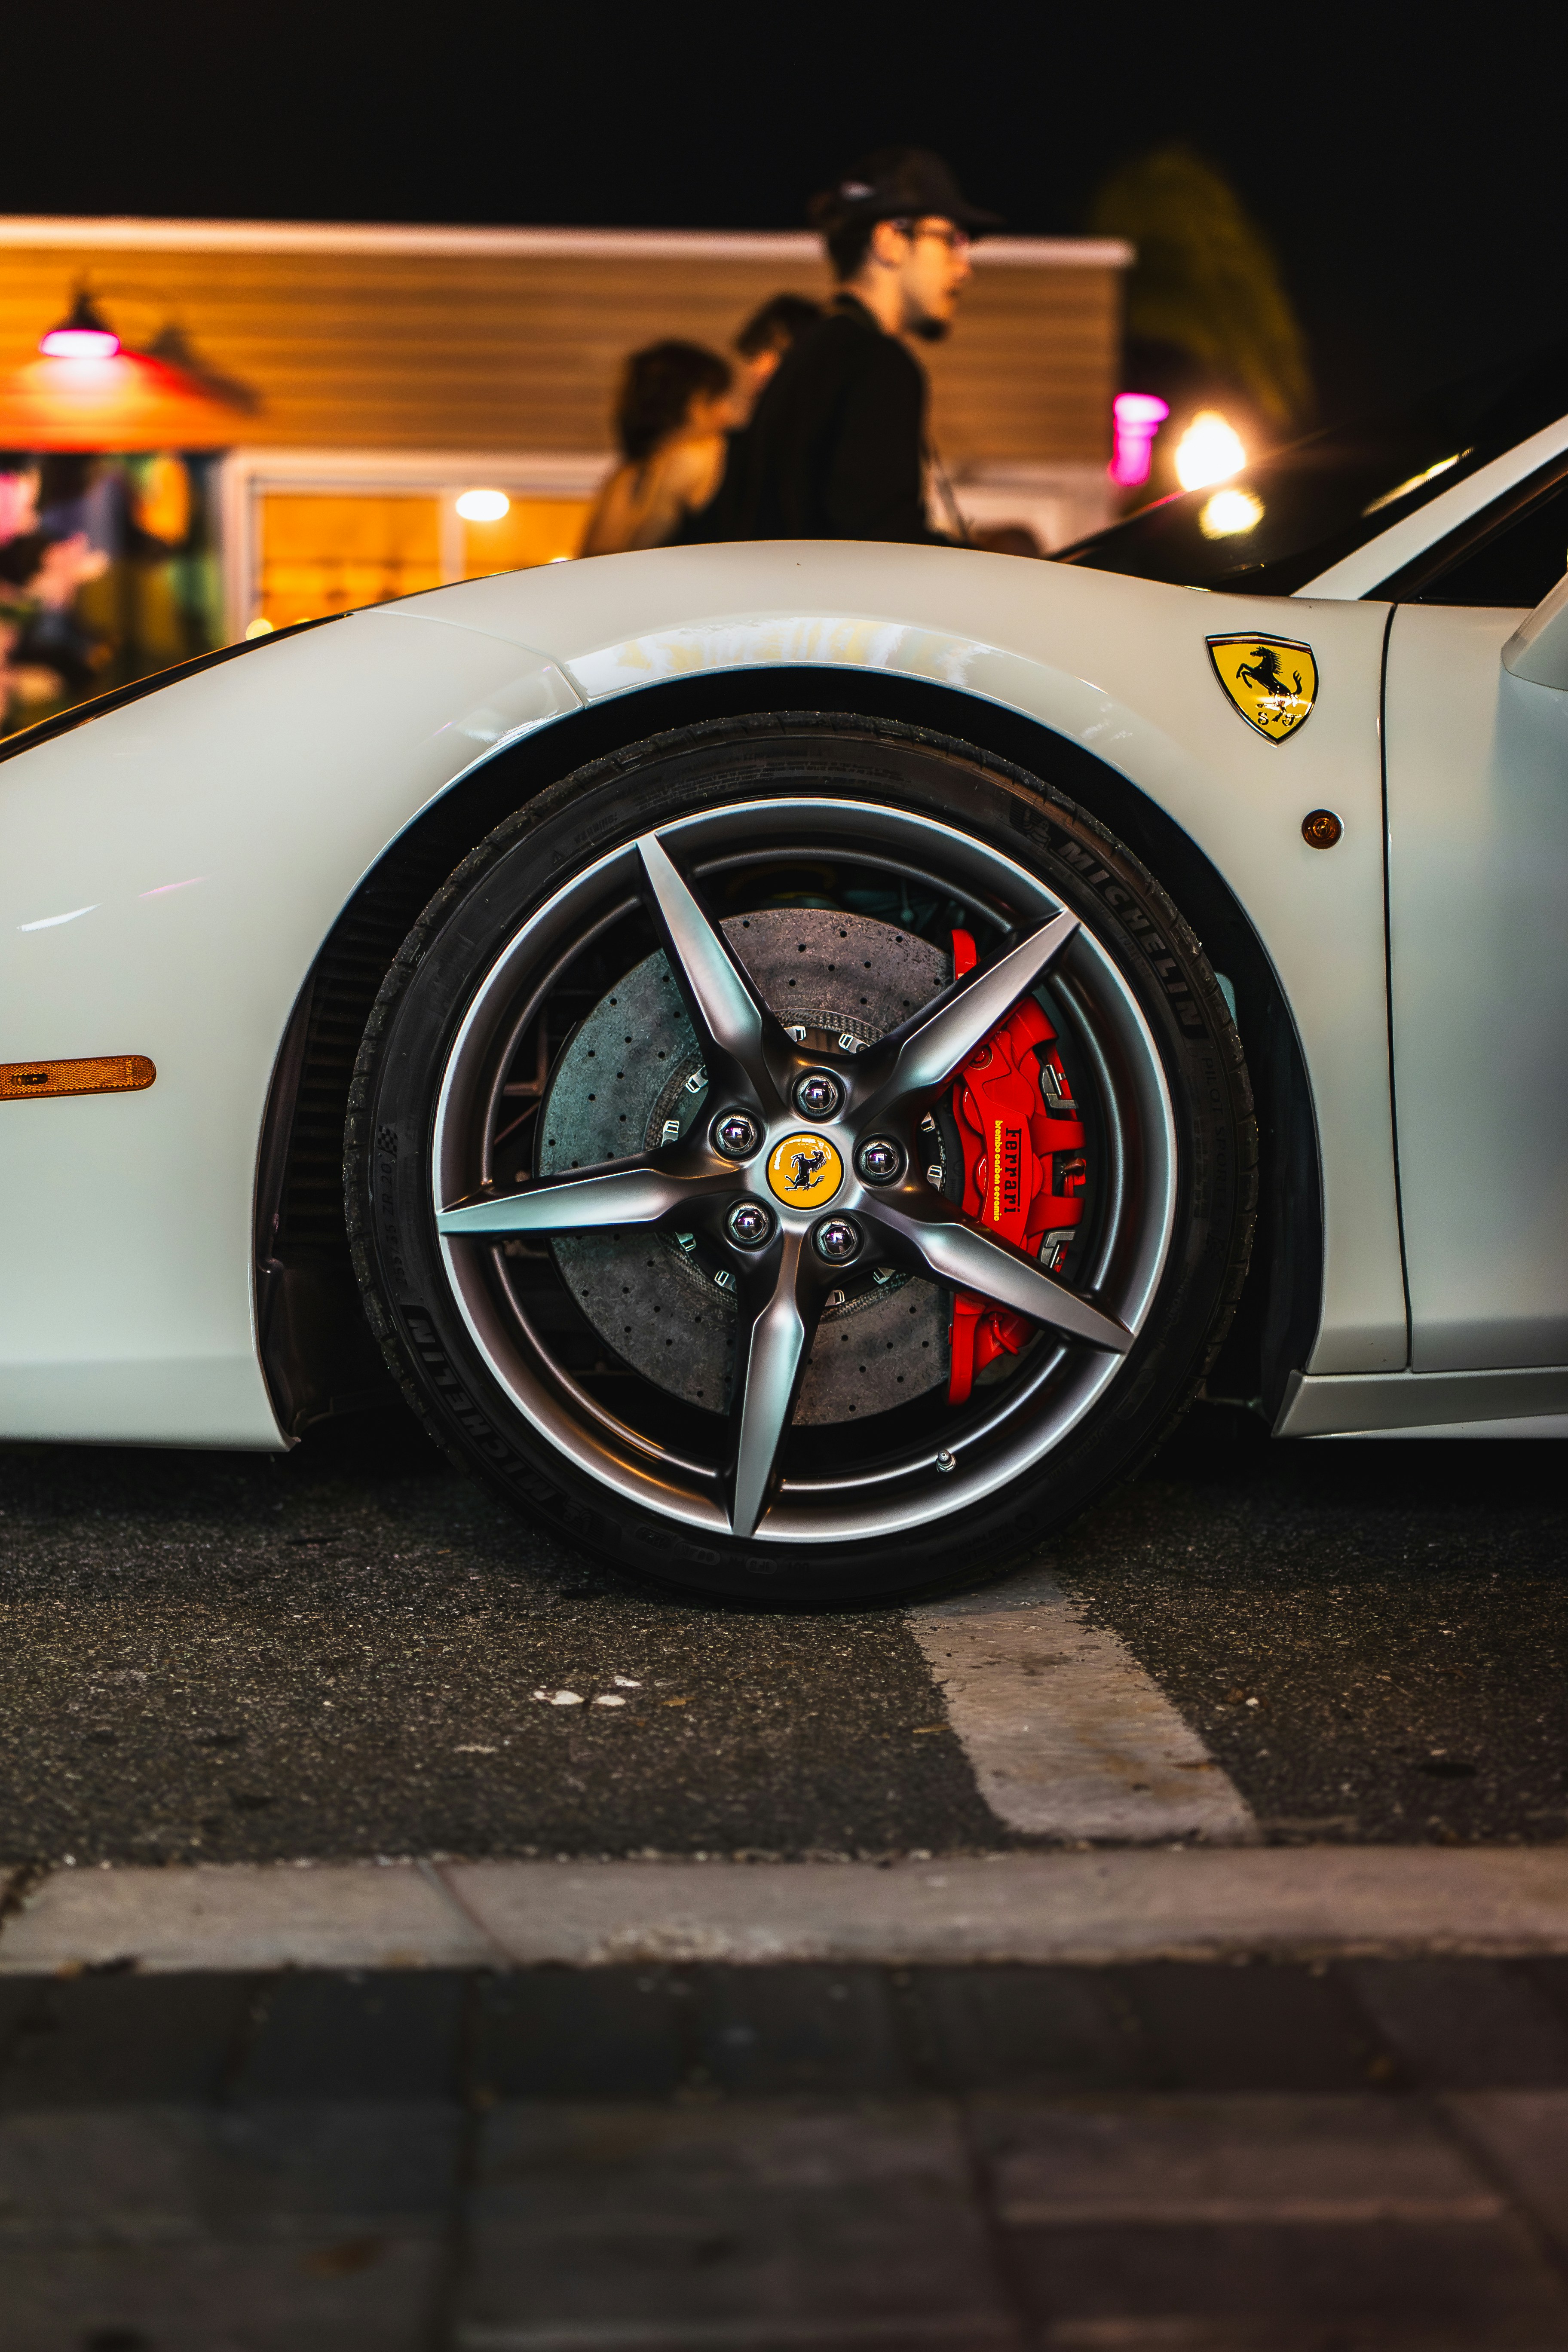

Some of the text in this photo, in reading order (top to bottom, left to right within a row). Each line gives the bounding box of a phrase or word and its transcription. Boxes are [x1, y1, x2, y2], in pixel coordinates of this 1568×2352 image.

[1057, 840, 1203, 1026] MICHELIN
[380, 1163, 392, 1187] 20
[994, 1120, 1003, 1221] brembo carbon ceramic
[1004, 1127, 1022, 1214] Ferrari
[1204, 1060, 1223, 1114] PILOT
[1215, 1127, 1227, 1198] SPORT
[381, 1193, 394, 1216] ZR
[406, 1317, 557, 1504] MICHELIN
